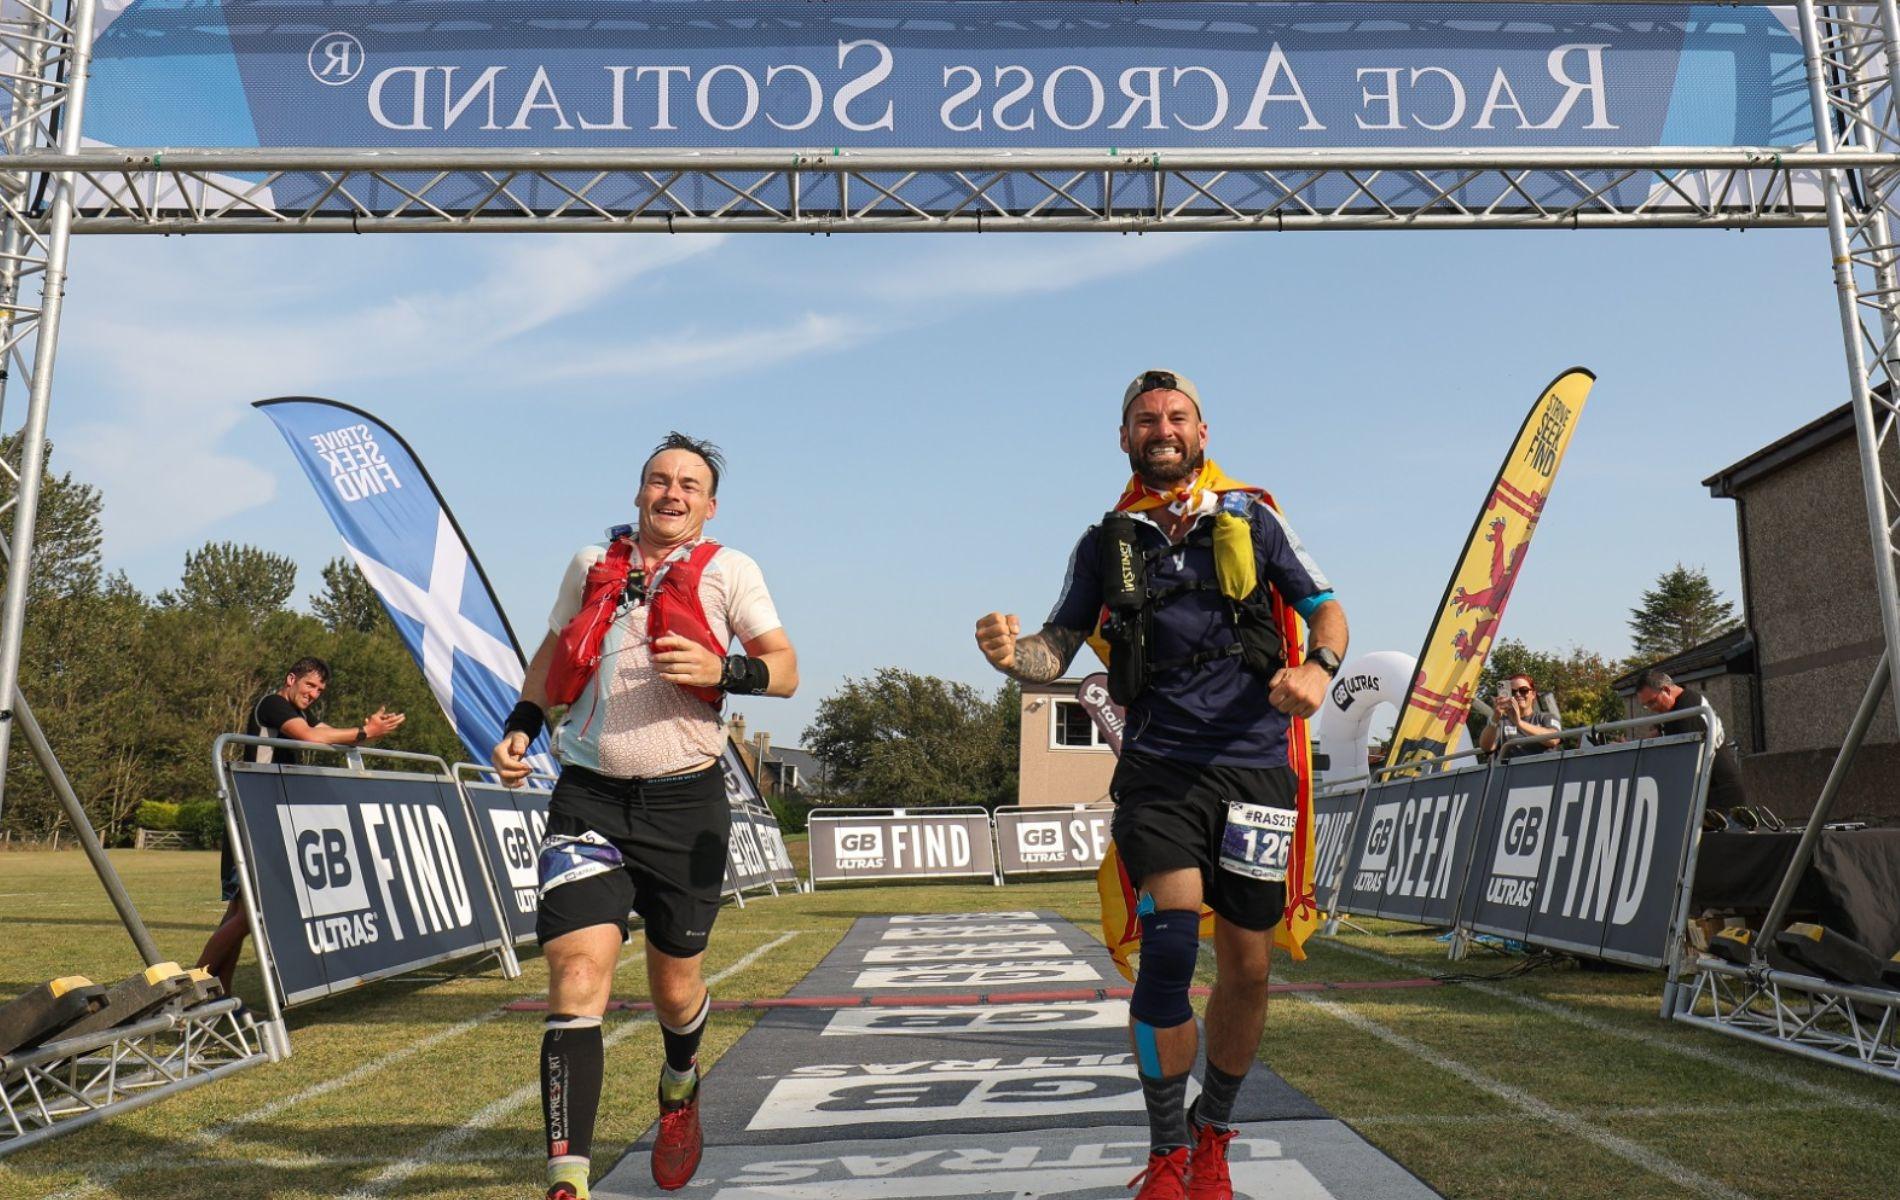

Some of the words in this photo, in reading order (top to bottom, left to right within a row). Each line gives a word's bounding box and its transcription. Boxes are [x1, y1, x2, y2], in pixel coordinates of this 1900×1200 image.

[1536, 412, 1565, 451] SEEK
[1523, 434, 1556, 477] FIND
[1347, 674, 1380, 693] ULTRAS
[502, 827, 533, 869] GB
[841, 834, 877, 851] GB
[890, 823, 971, 869] FIND
[1023, 828, 1057, 846] GB
[1243, 829, 1292, 867] 126
[1367, 818, 1393, 856] GB
[1386, 793, 1469, 900] SEEK
[1504, 806, 1544, 857] GB
[1540, 775, 1659, 926] FIND
[296, 828, 352, 891] GB
[359, 803, 472, 942] FIND
[836, 857, 885, 870] ULTRAS
[1020, 852, 1066, 864] ULTRAS
[1354, 872, 1385, 893] ULTRAS
[1486, 876, 1536, 907] ULTRAS
[305, 912, 379, 955] ULTRAS
[866, 1009, 1100, 1028] GB
[815, 1075, 1145, 1112] GB
